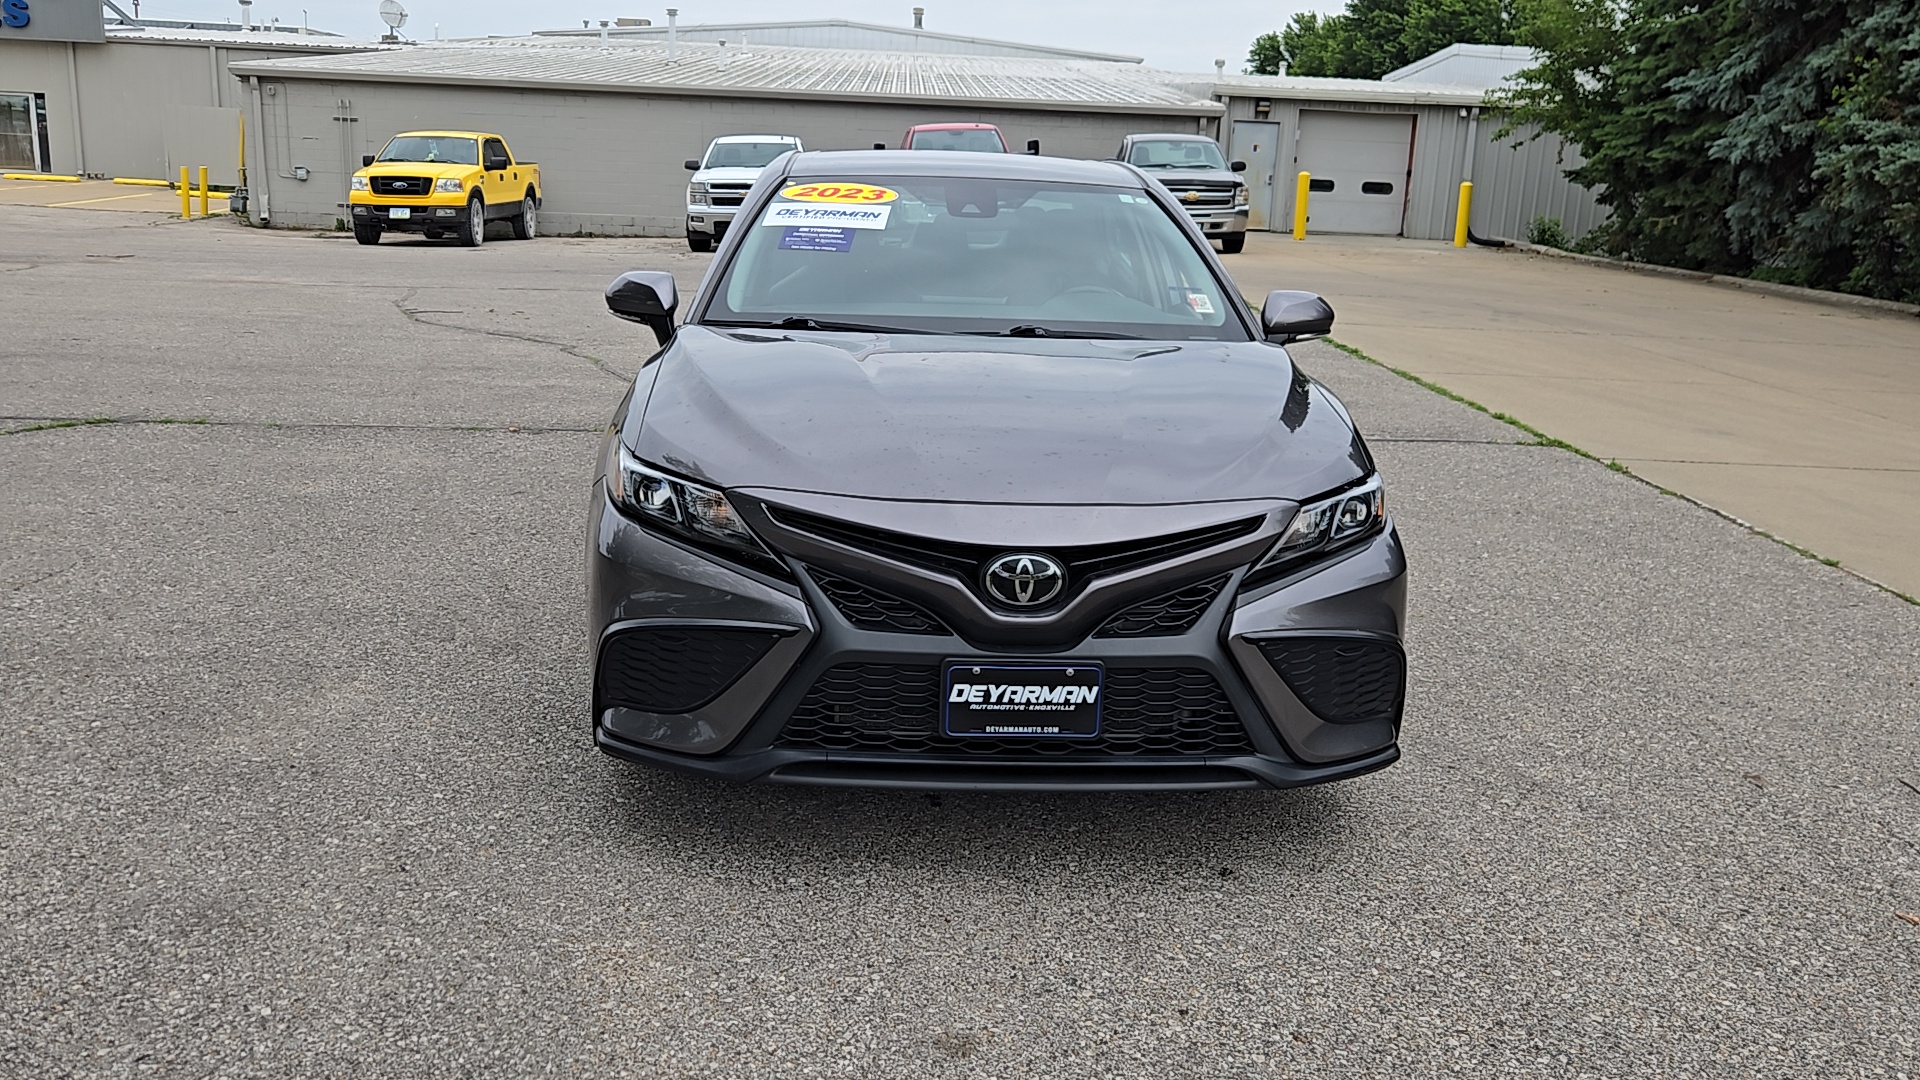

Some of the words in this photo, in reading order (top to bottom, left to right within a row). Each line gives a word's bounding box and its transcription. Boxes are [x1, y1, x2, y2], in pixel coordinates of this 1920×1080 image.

[791, 186, 888, 201] 2023
[775, 208, 882, 219] DEYARMAN
[949, 684, 1100, 704] DEYARMAN
[985, 725, 1060, 734] DEYARMANAUTO.COM
